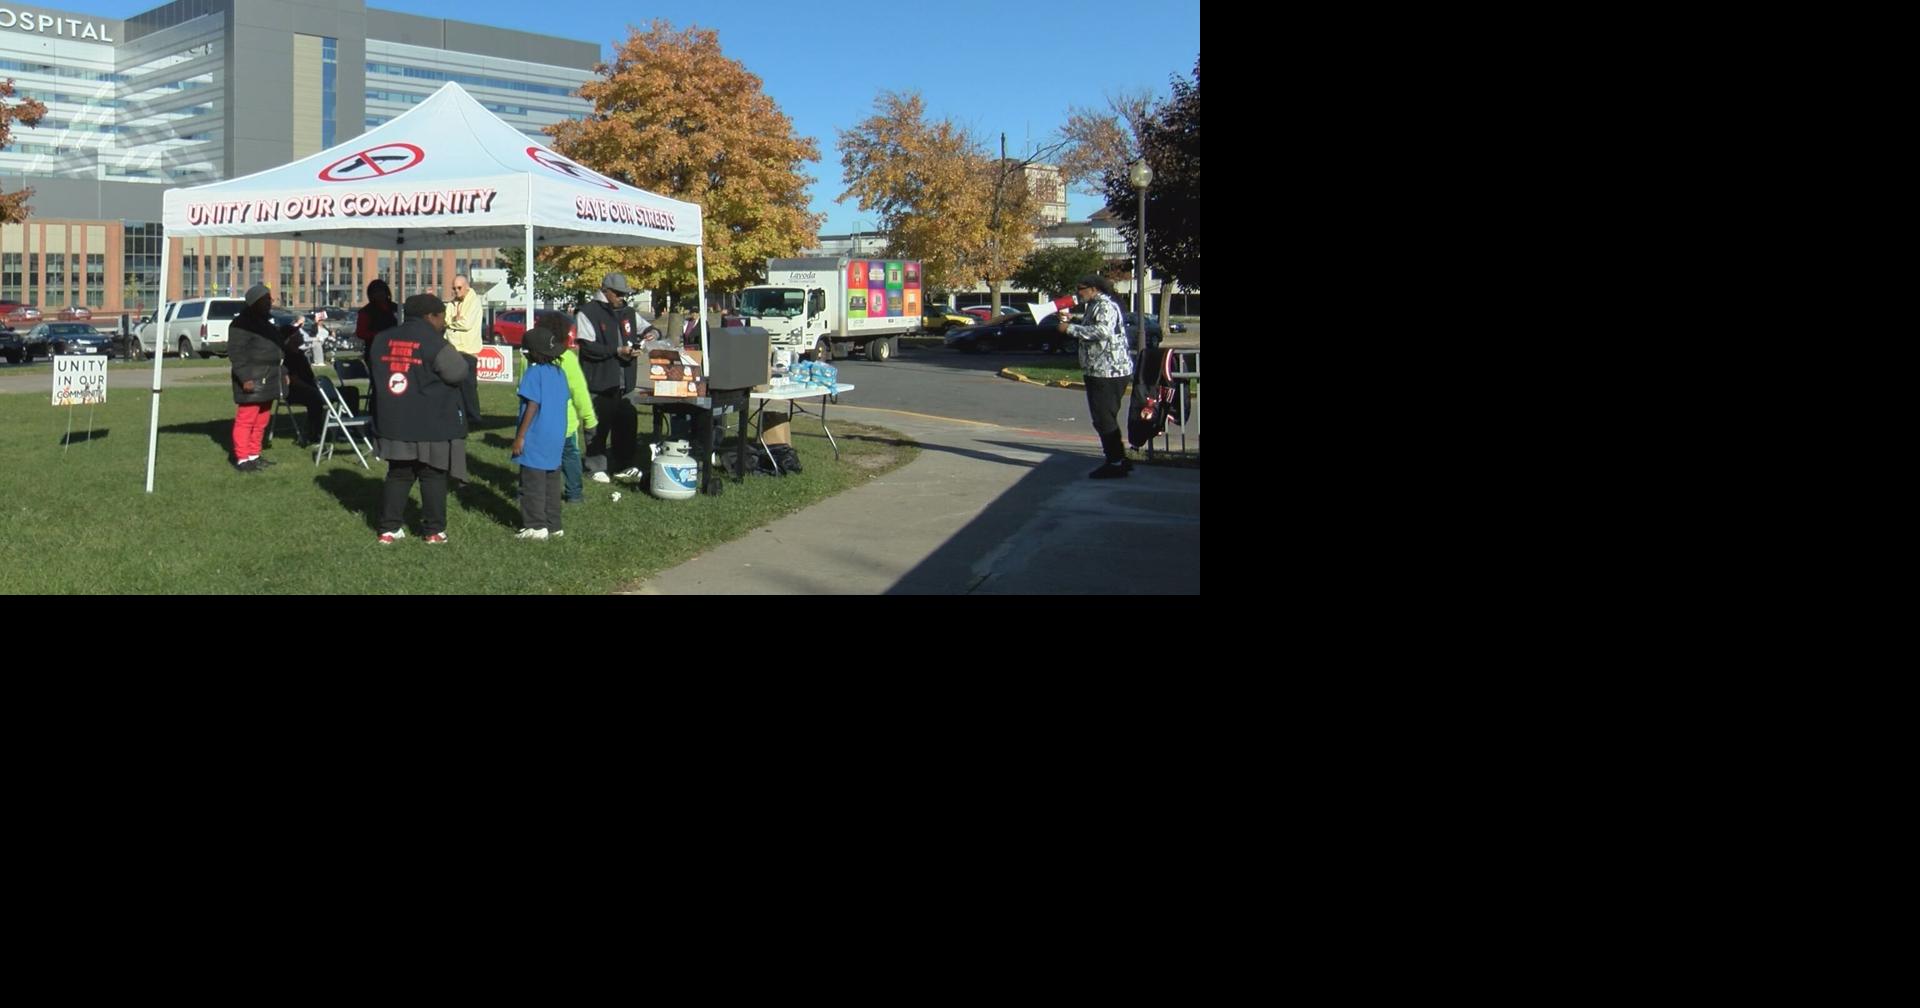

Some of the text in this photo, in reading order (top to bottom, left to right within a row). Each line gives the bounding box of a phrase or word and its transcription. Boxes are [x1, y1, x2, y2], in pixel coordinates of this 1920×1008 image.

[187, 189, 496, 225] UNITY IN OUR COMMUNITY
[576, 196, 676, 232] SAVE OUR STREETS
[57, 360, 104, 372] UNITY
[58, 375, 105, 385] IN OUR
